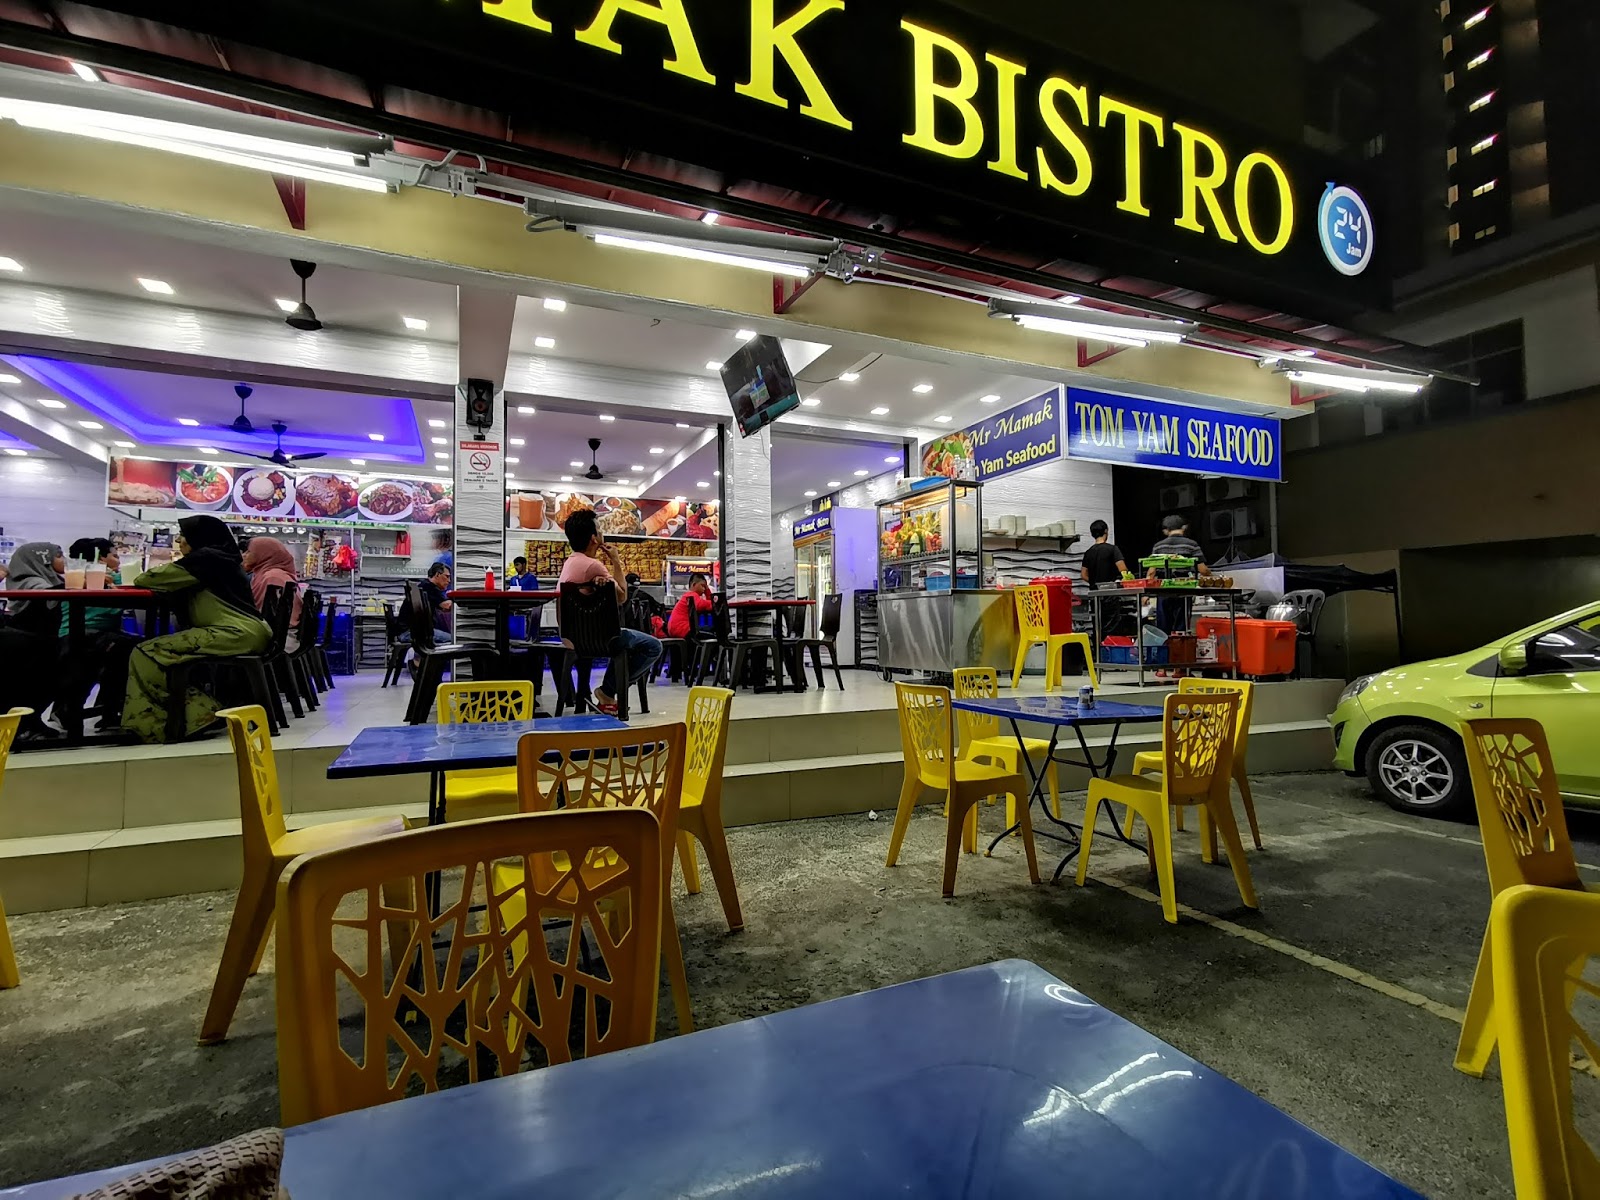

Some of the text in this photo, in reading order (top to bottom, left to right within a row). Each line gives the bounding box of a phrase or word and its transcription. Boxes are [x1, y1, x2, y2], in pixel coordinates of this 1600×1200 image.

[901, 19, 1294, 255] BISTRO
[1334, 206, 1362, 244] 24
[1346, 242, 1362, 258] Jam
[968, 398, 1053, 449] Mr Mamak
[1075, 401, 1273, 467] TOM YAM SEAFOOD
[981, 456, 1003, 475] Yam
[1006, 434, 1056, 468] Seafood
